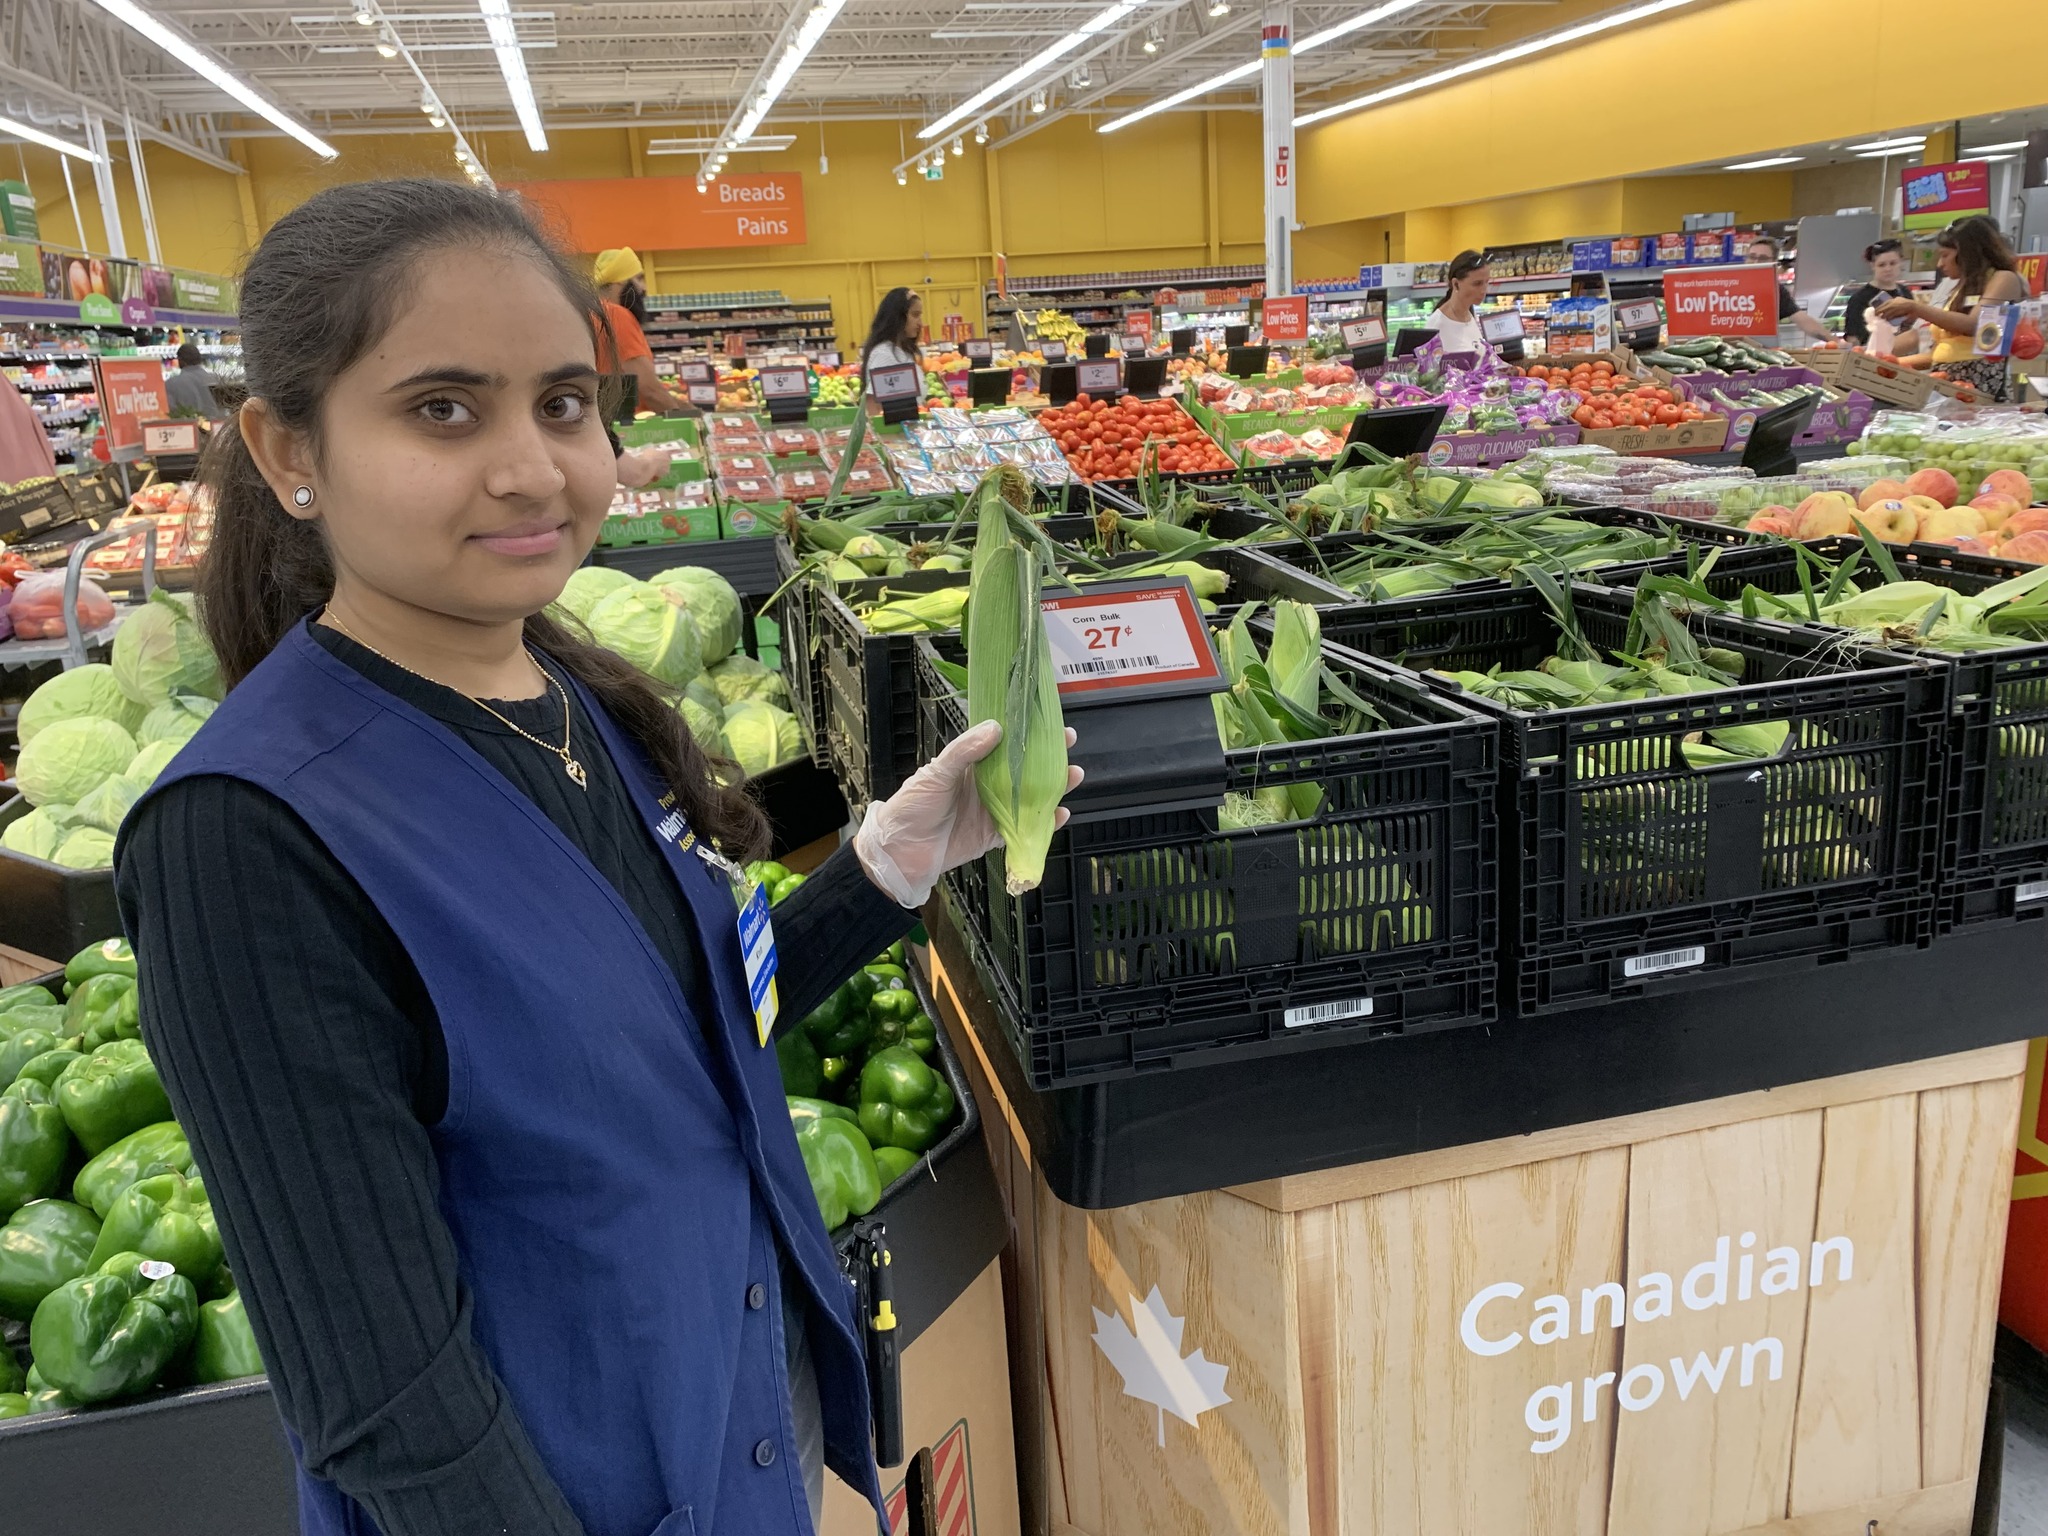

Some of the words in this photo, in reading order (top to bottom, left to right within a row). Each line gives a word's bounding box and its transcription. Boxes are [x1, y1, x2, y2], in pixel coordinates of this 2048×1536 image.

[719, 181, 786, 203] Breads
[737, 216, 788, 236] Pains
[1675, 292, 1706, 313] Low
[1708, 290, 1756, 313] Prices
[1267, 313, 1279, 326] Low
[1280, 310, 1298, 325] Prices
[1711, 314, 1735, 329] Every
[1736, 313, 1754, 328] day
[112, 388, 133, 415] Low
[131, 386, 159, 413] Prices
[1242, 418, 1273, 431] BECAUSE
[1315, 414, 1347, 427] MATTERS
[1483, 438, 1540, 458] CUCUMBERS
[1621, 434, 1646, 450] FRESH
[1136, 593, 1157, 601] SAVE
[1072, 616, 1096, 625] Corn
[1100, 613, 1121, 622] Bulk
[1460, 1231, 1854, 1356] Canadian
[1524, 1336, 1784, 1454] grown
